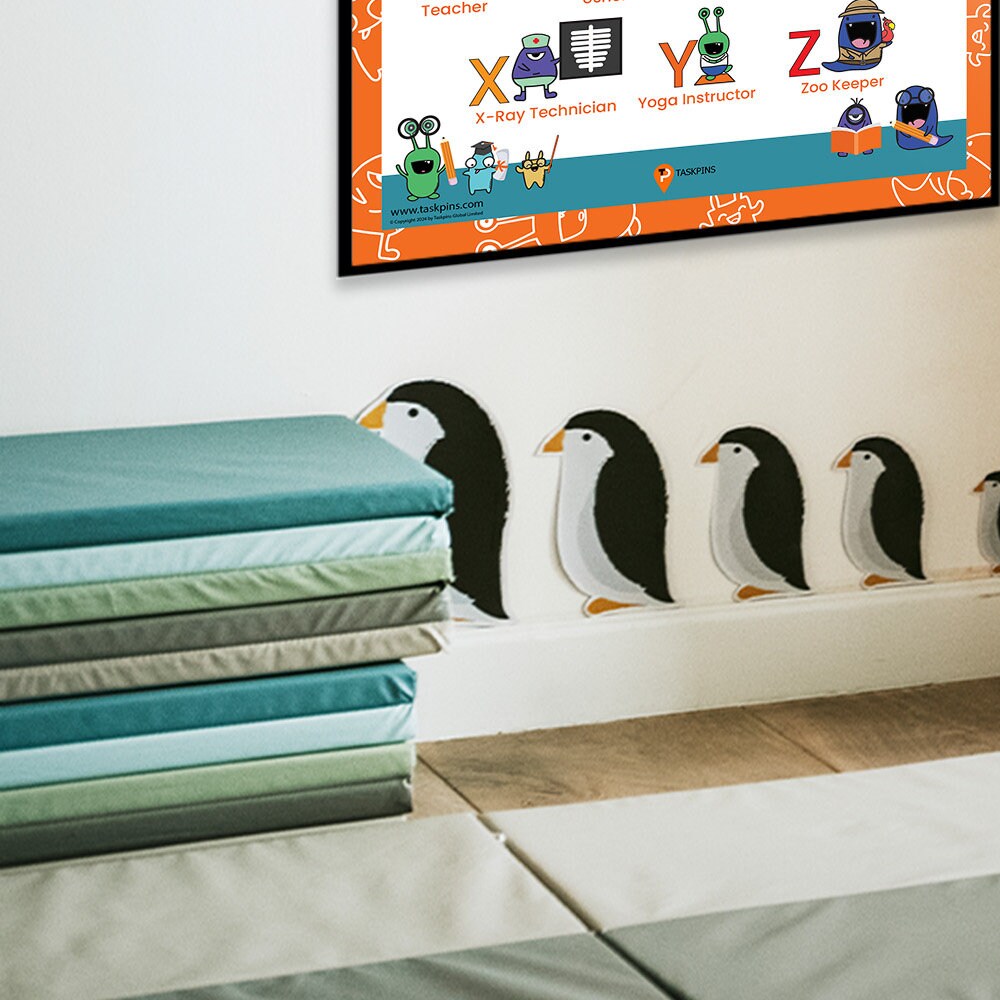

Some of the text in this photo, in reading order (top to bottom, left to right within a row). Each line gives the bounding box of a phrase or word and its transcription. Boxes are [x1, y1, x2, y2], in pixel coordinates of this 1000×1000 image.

[421, 1, 488, 17] Teacher
[658, 39, 698, 88] Y
[788, 29, 821, 78] Z
[469, 56, 510, 107] X
[801, 75, 884, 94] Zoo Keeper
[638, 88, 756, 111] Yoga Instructor
[475, 100, 617, 125] X-Ray Technician
[675, 165, 717, 177] TASKPINS
[390, 200, 484, 216] www.taskpins.com
